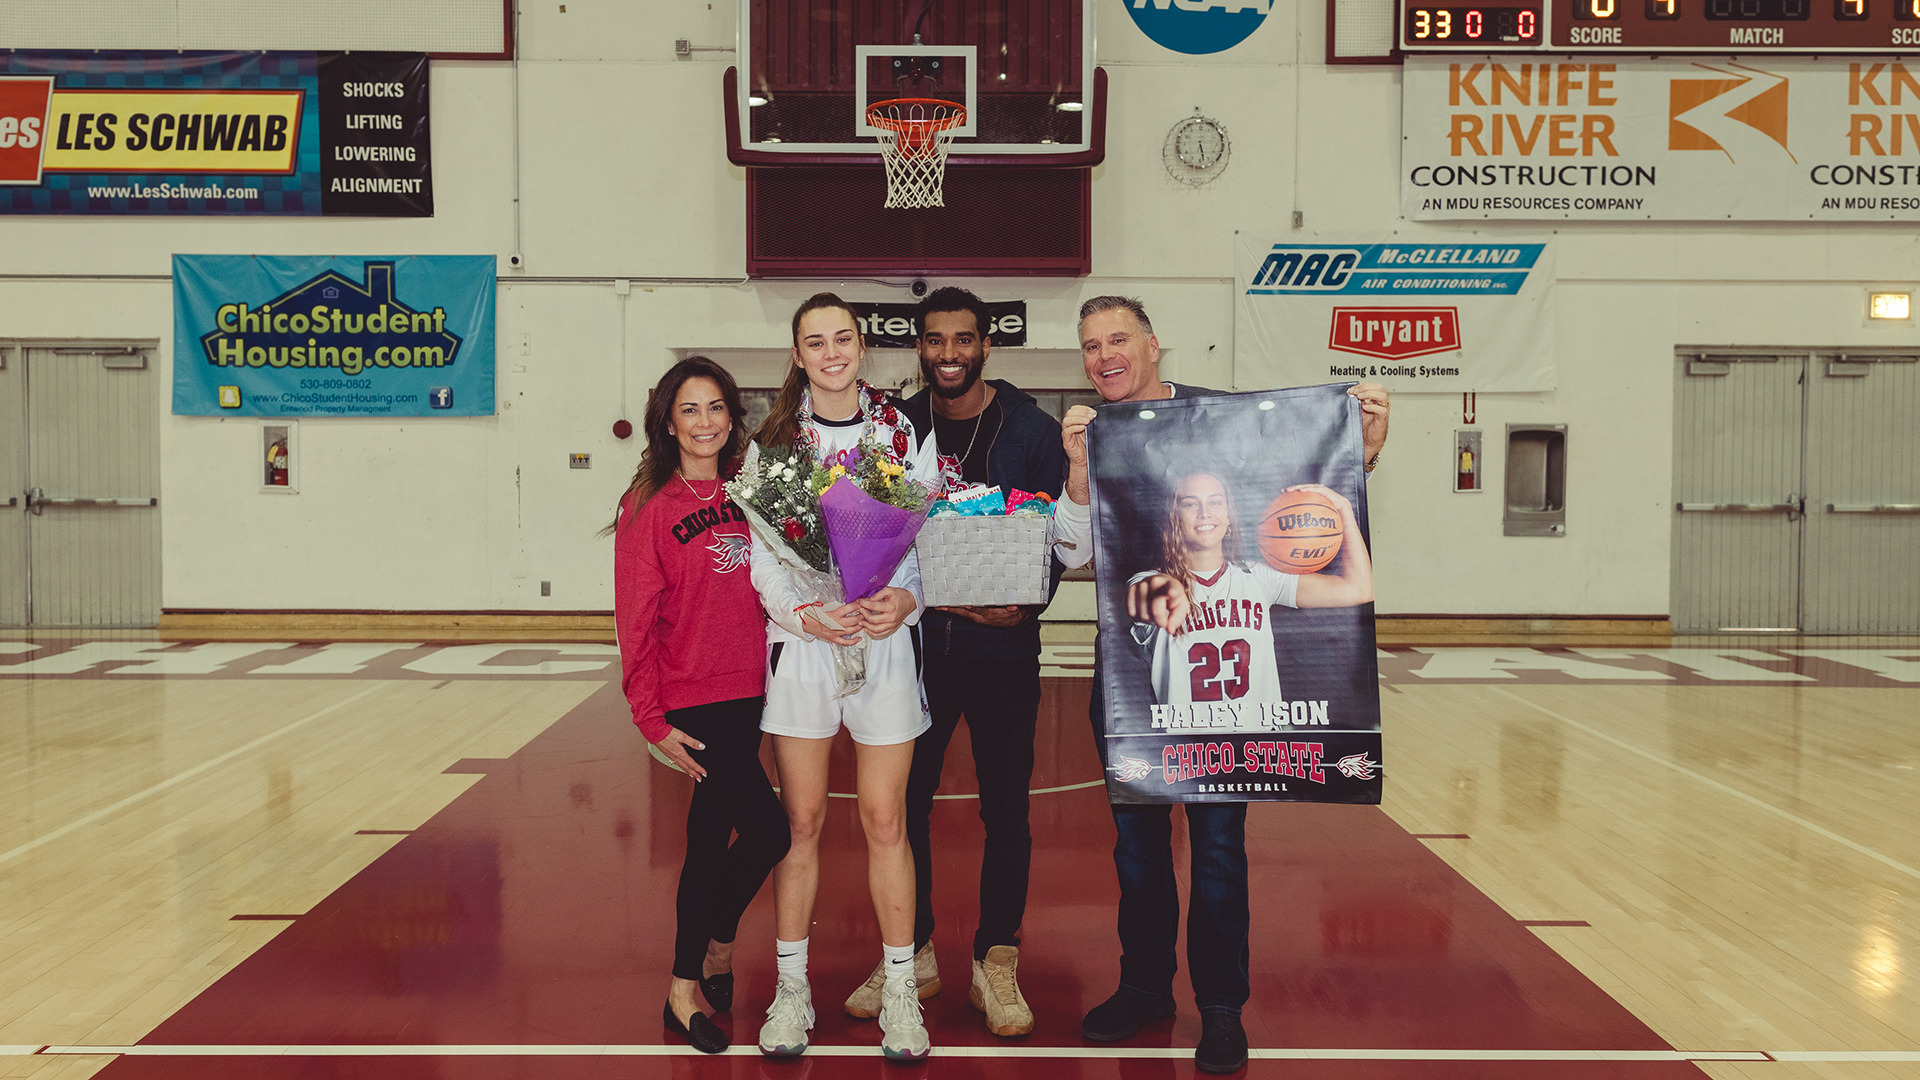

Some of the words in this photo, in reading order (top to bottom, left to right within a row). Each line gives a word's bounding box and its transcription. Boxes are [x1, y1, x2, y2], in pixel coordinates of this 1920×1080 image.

[1415, 10, 1451, 38] 33
[1465, 10, 1483, 38] 0
[1518, 10, 1535, 38] 0
[1570, 27, 1622, 44] SCORE
[1730, 28, 1784, 44] MATCH
[343, 82, 404, 98] SHOCKS
[1448, 63, 1619, 106] KNIFE
[346, 114, 402, 130] LIFTING
[56, 113, 115, 151] LES
[126, 113, 288, 151] SCHWAB
[1446, 114, 1620, 156] RIVER
[335, 146, 416, 161] LOWERING
[1410, 165, 1656, 186] CONSTRUCTION
[1810, 165, 1920, 185] CONST
[88, 183, 258, 199] www.LesSchwab.com
[331, 178, 423, 193] ALIGNMENT
[1422, 198, 1442, 210] AN
[1446, 198, 1479, 210] MDU
[1483, 197, 1570, 210] RESOURCES
[1574, 198, 1644, 210] COMPANY
[1821, 198, 1840, 209] AN
[1845, 198, 1876, 209] MDU
[1251, 253, 1358, 286] MAC
[1361, 279, 1387, 289] AIR
[1392, 278, 1491, 289] CONDITIONING
[216, 303, 446, 334] ChicoStudent
[1350, 315, 1442, 347] bryant
[218, 338, 445, 374] Housing.com
[1330, 365, 1366, 378] Heating
[1369, 366, 1377, 376] &
[1380, 365, 1416, 378] Cooling
[1419, 365, 1459, 378] Systems
[300, 379, 371, 389] 530-809-0802
[252, 393, 418, 404] www.ChicoStudentHousing.com
[316, 405, 345, 413] Property
[672, 506, 720, 545] CHICO
[1277, 512, 1336, 531] Wilson
[1290, 546, 1327, 558] EVO
[1188, 638, 1250, 702] 23
[1150, 703, 1246, 729] HALEY
[1260, 700, 1330, 726] ISON
[1162, 741, 1235, 785] CHICO
[1243, 741, 1326, 785] STATE
[1198, 783, 1288, 793] BASKETBALL
